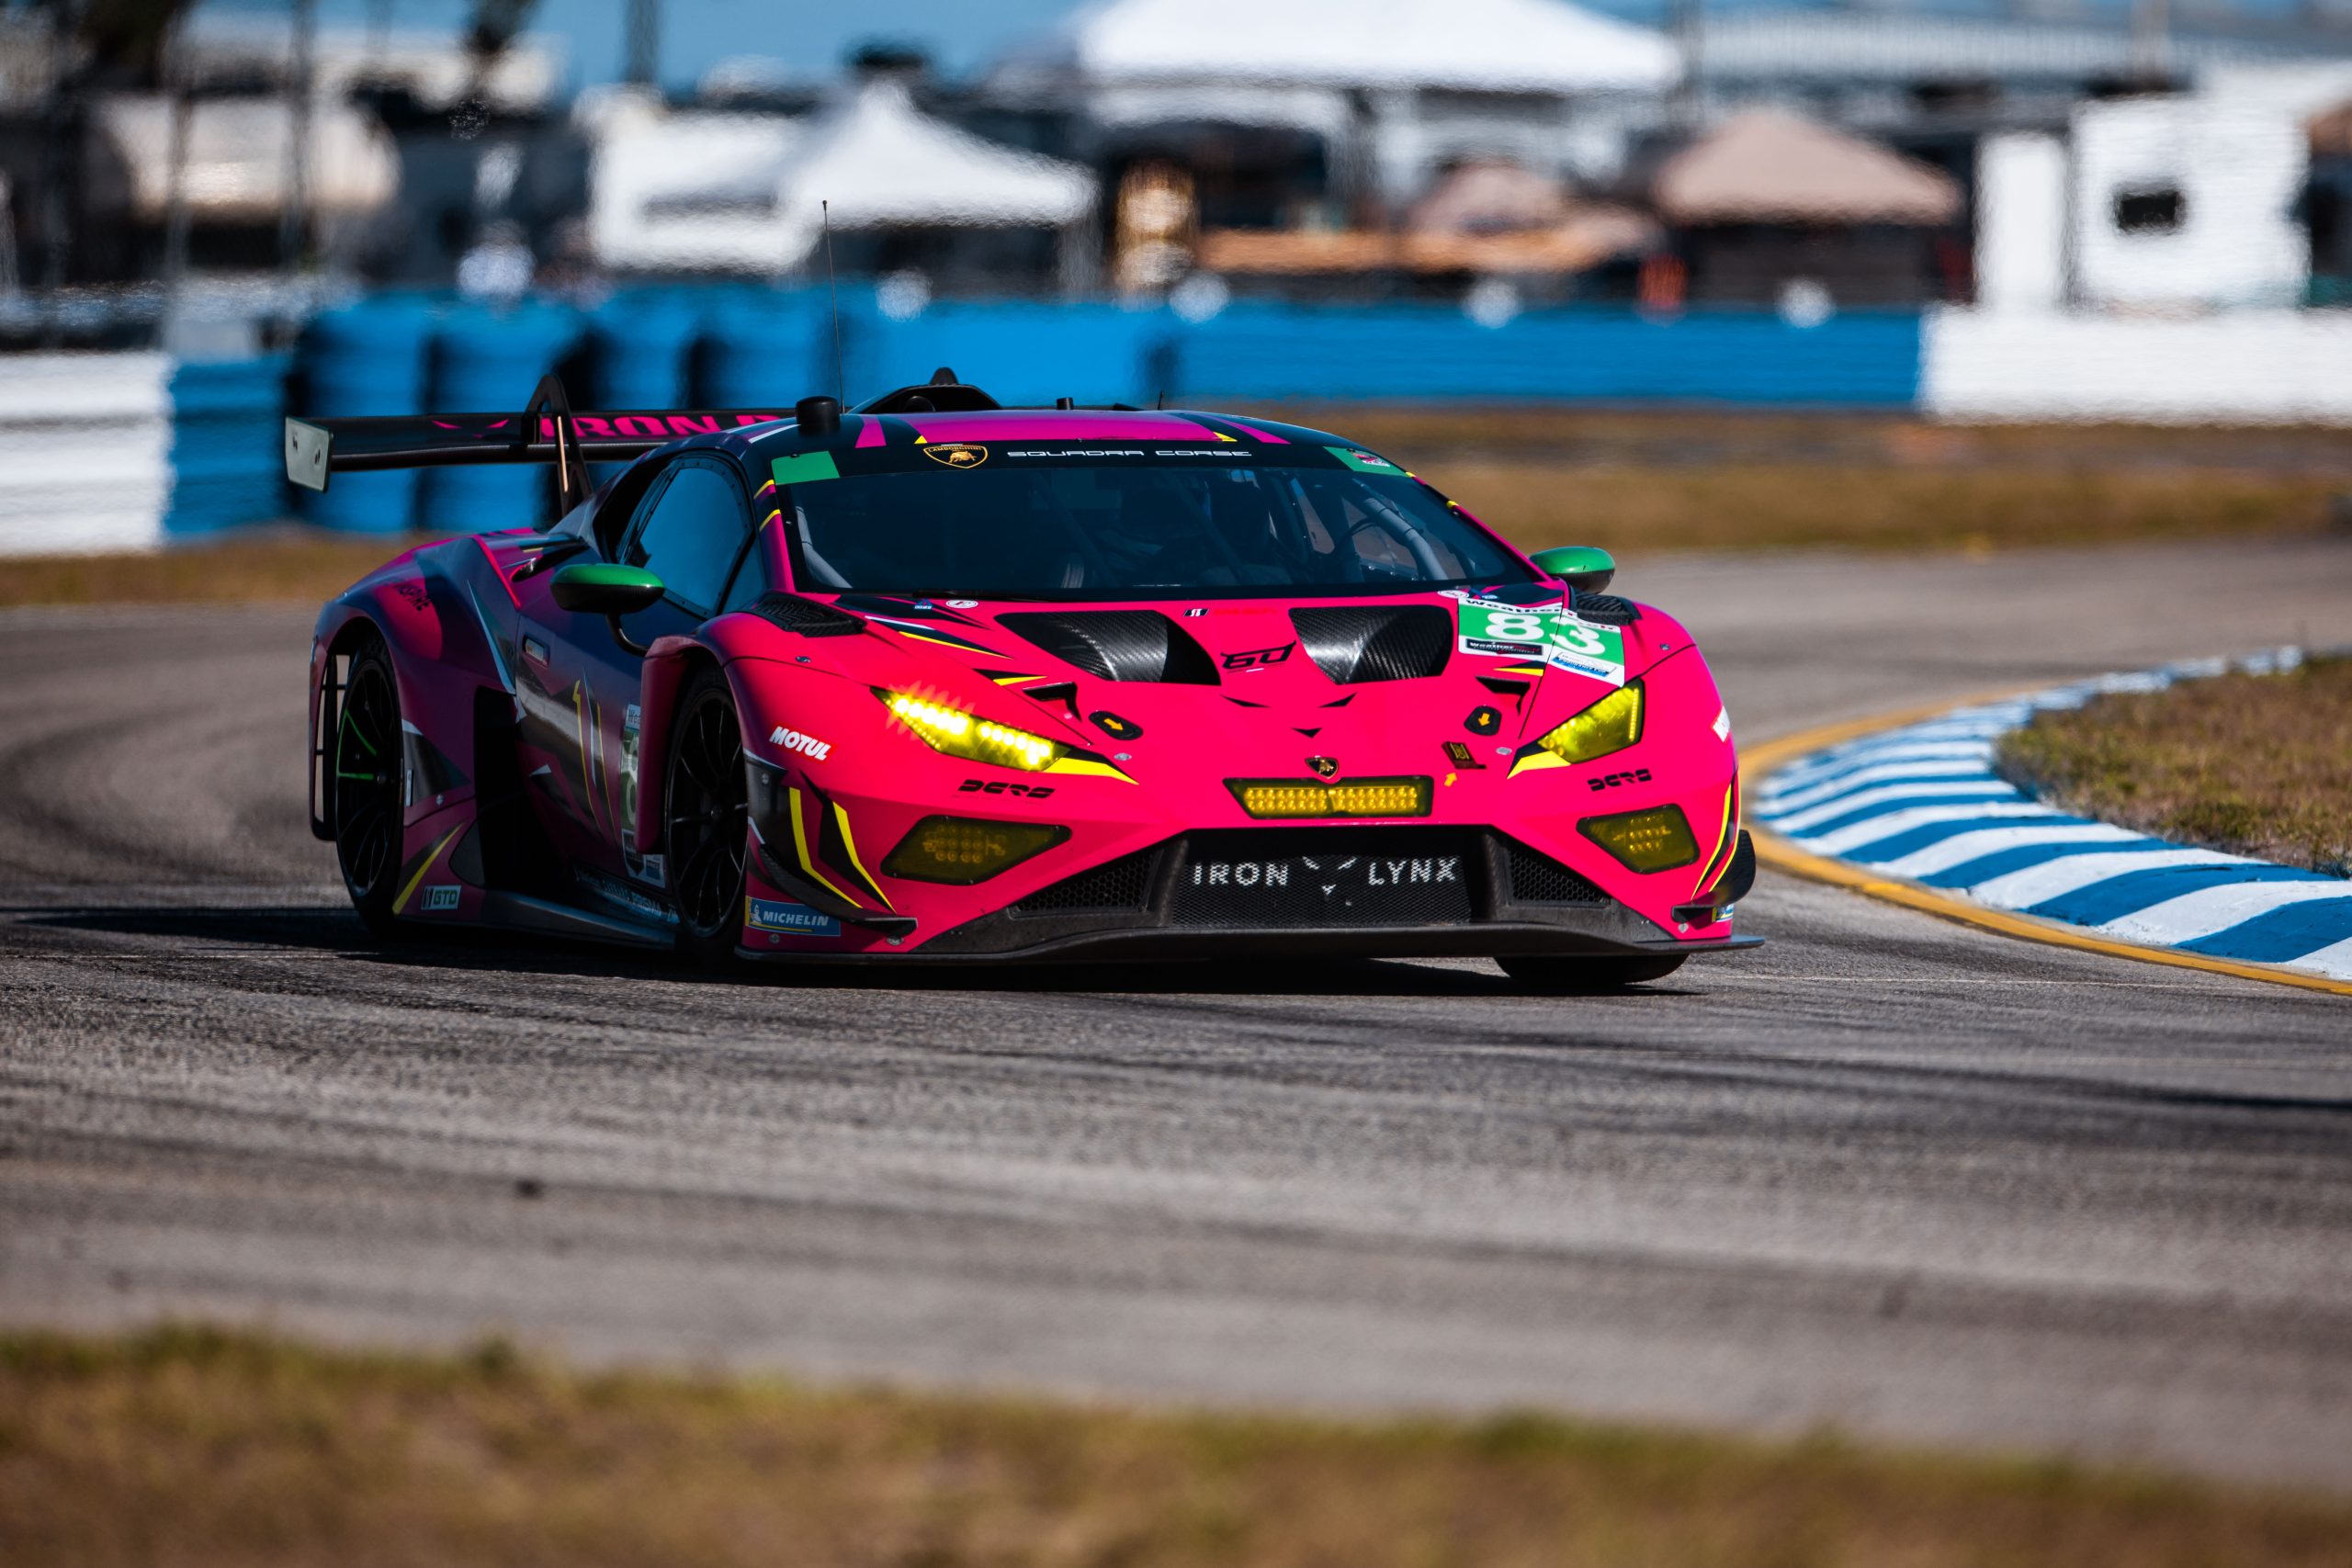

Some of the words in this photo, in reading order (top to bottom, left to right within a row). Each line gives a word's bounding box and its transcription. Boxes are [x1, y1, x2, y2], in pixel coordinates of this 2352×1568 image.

[540, 416, 721, 437] IRON
[1485, 612, 1606, 655] 83
[769, 726, 831, 761] MOTUL
[1193, 862, 1288, 886] IRON
[1368, 858, 1458, 886] LYNX
[434, 890, 458, 905] GTD
[763, 910, 830, 927] MICHELIN
